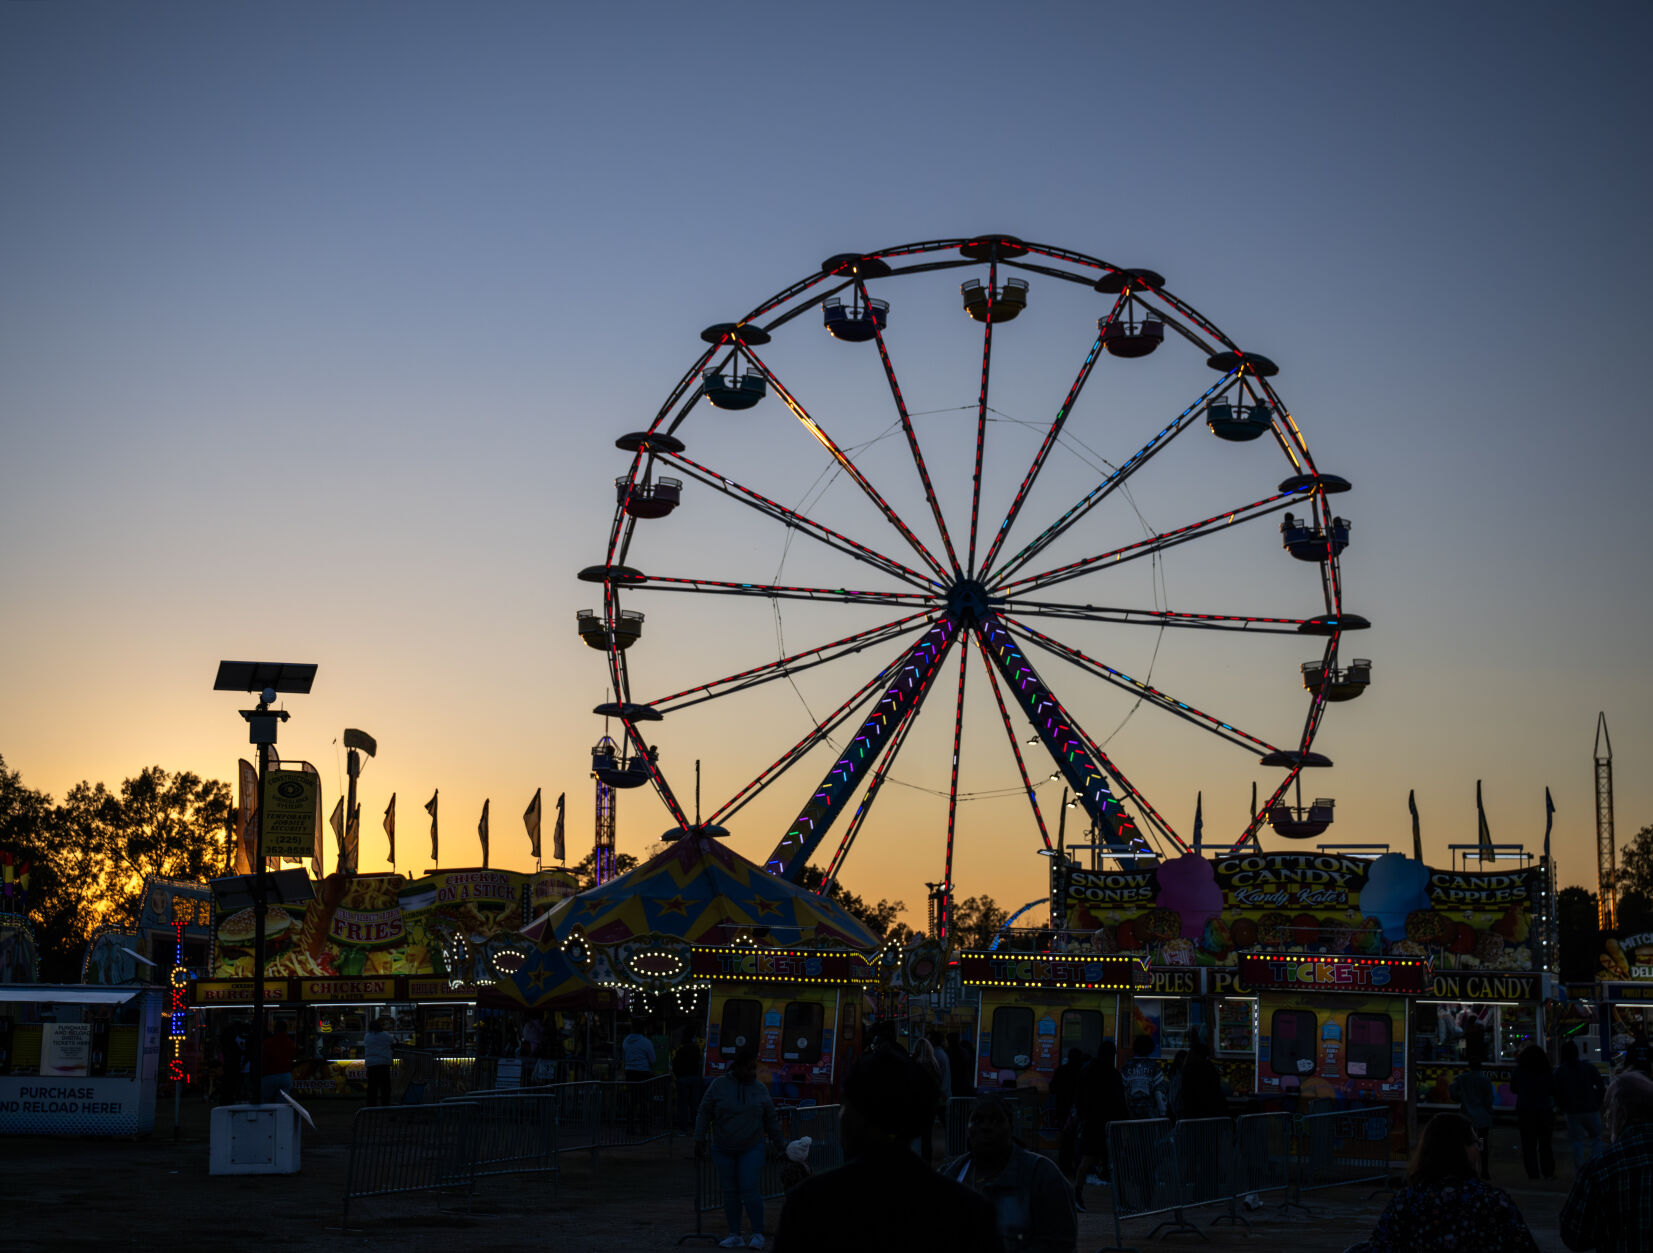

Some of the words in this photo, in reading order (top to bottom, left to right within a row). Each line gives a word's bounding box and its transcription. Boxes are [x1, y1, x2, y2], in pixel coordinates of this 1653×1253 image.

[1217, 855, 1366, 876] COTTON
[445, 873, 509, 885] CHICKEN
[1071, 872, 1152, 888] SNOW
[1231, 869, 1352, 887] CANDY
[1431, 873, 1528, 889] CANDY
[438, 887, 457, 901] ON
[461, 885, 471, 899] A
[473, 884, 516, 900] STICK
[1068, 886, 1153, 901] CONES
[1234, 888, 1290, 906] Kandy
[1296, 888, 1347, 905] Kate's
[1430, 887, 1527, 903] APPLES
[332, 918, 401, 941] FRIES
[1619, 932, 1653, 951] MITC
[310, 982, 386, 993] CHICKEN
[1466, 976, 1535, 999] CANDY
[168, 921, 187, 1081] TICKETS
[20, 1087, 94, 1099] PURCHASE
[0, 1101, 19, 1112] ND
[23, 1101, 78, 1113] RELOAD
[82, 1102, 122, 1114] HERE!
